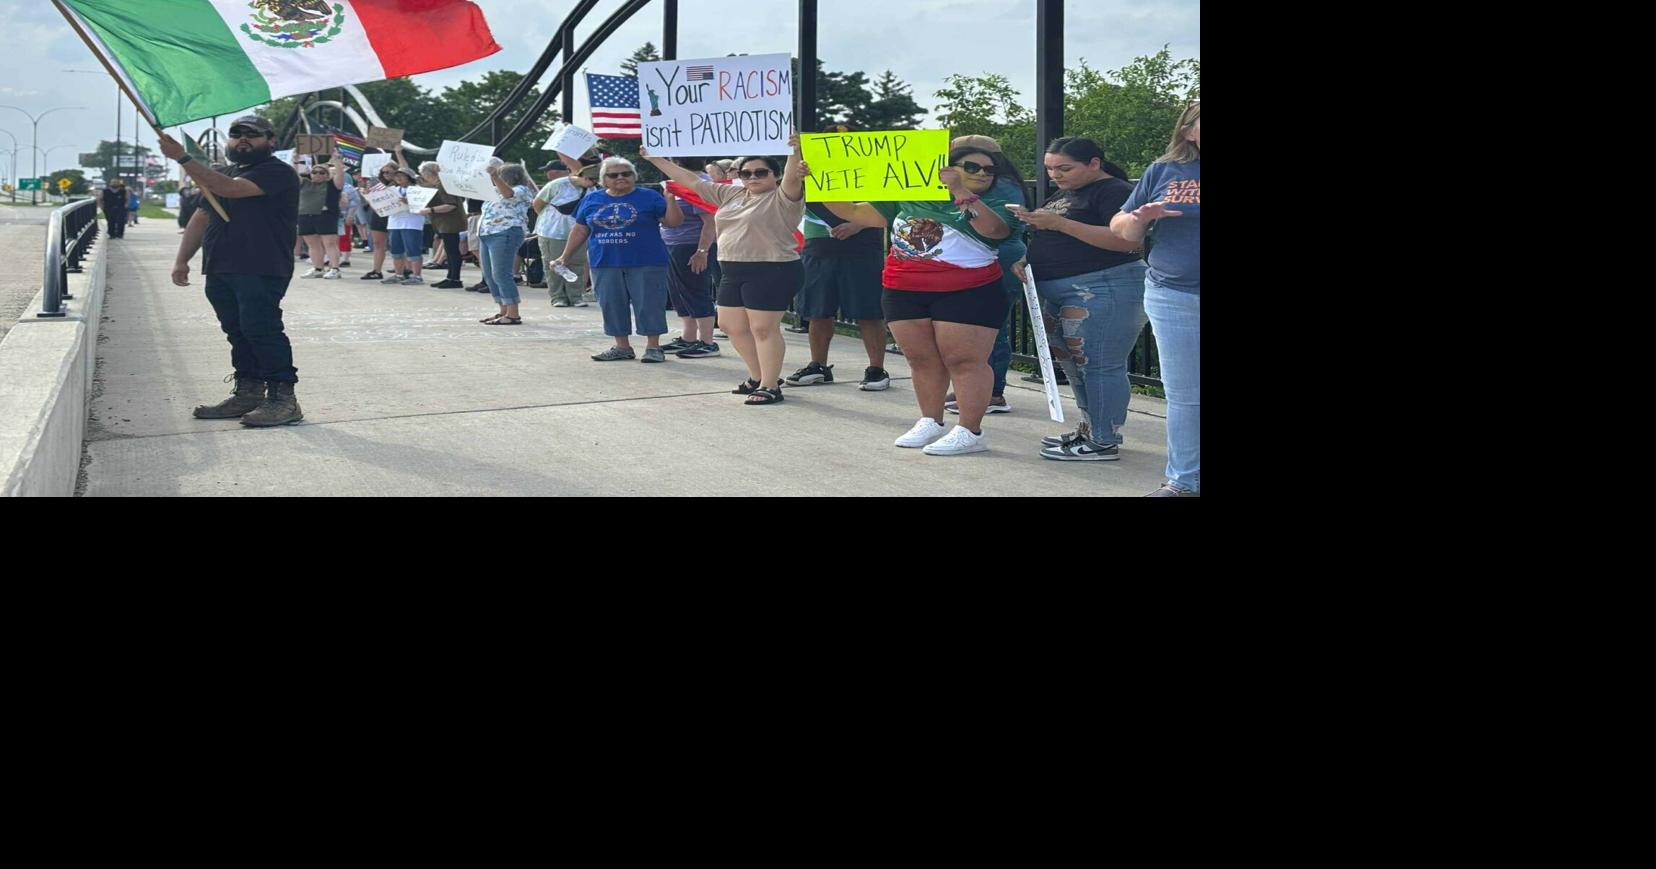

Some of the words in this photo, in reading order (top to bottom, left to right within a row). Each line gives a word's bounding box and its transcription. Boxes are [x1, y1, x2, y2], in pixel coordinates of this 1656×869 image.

[655, 66, 710, 106] Your
[719, 69, 791, 101] RACISM
[646, 118, 682, 148] isn't
[690, 109, 792, 146] PATRIOTISM
[811, 135, 907, 161] TRUMP
[809, 168, 865, 191] VETE
[1167, 179, 1200, 189] STA
